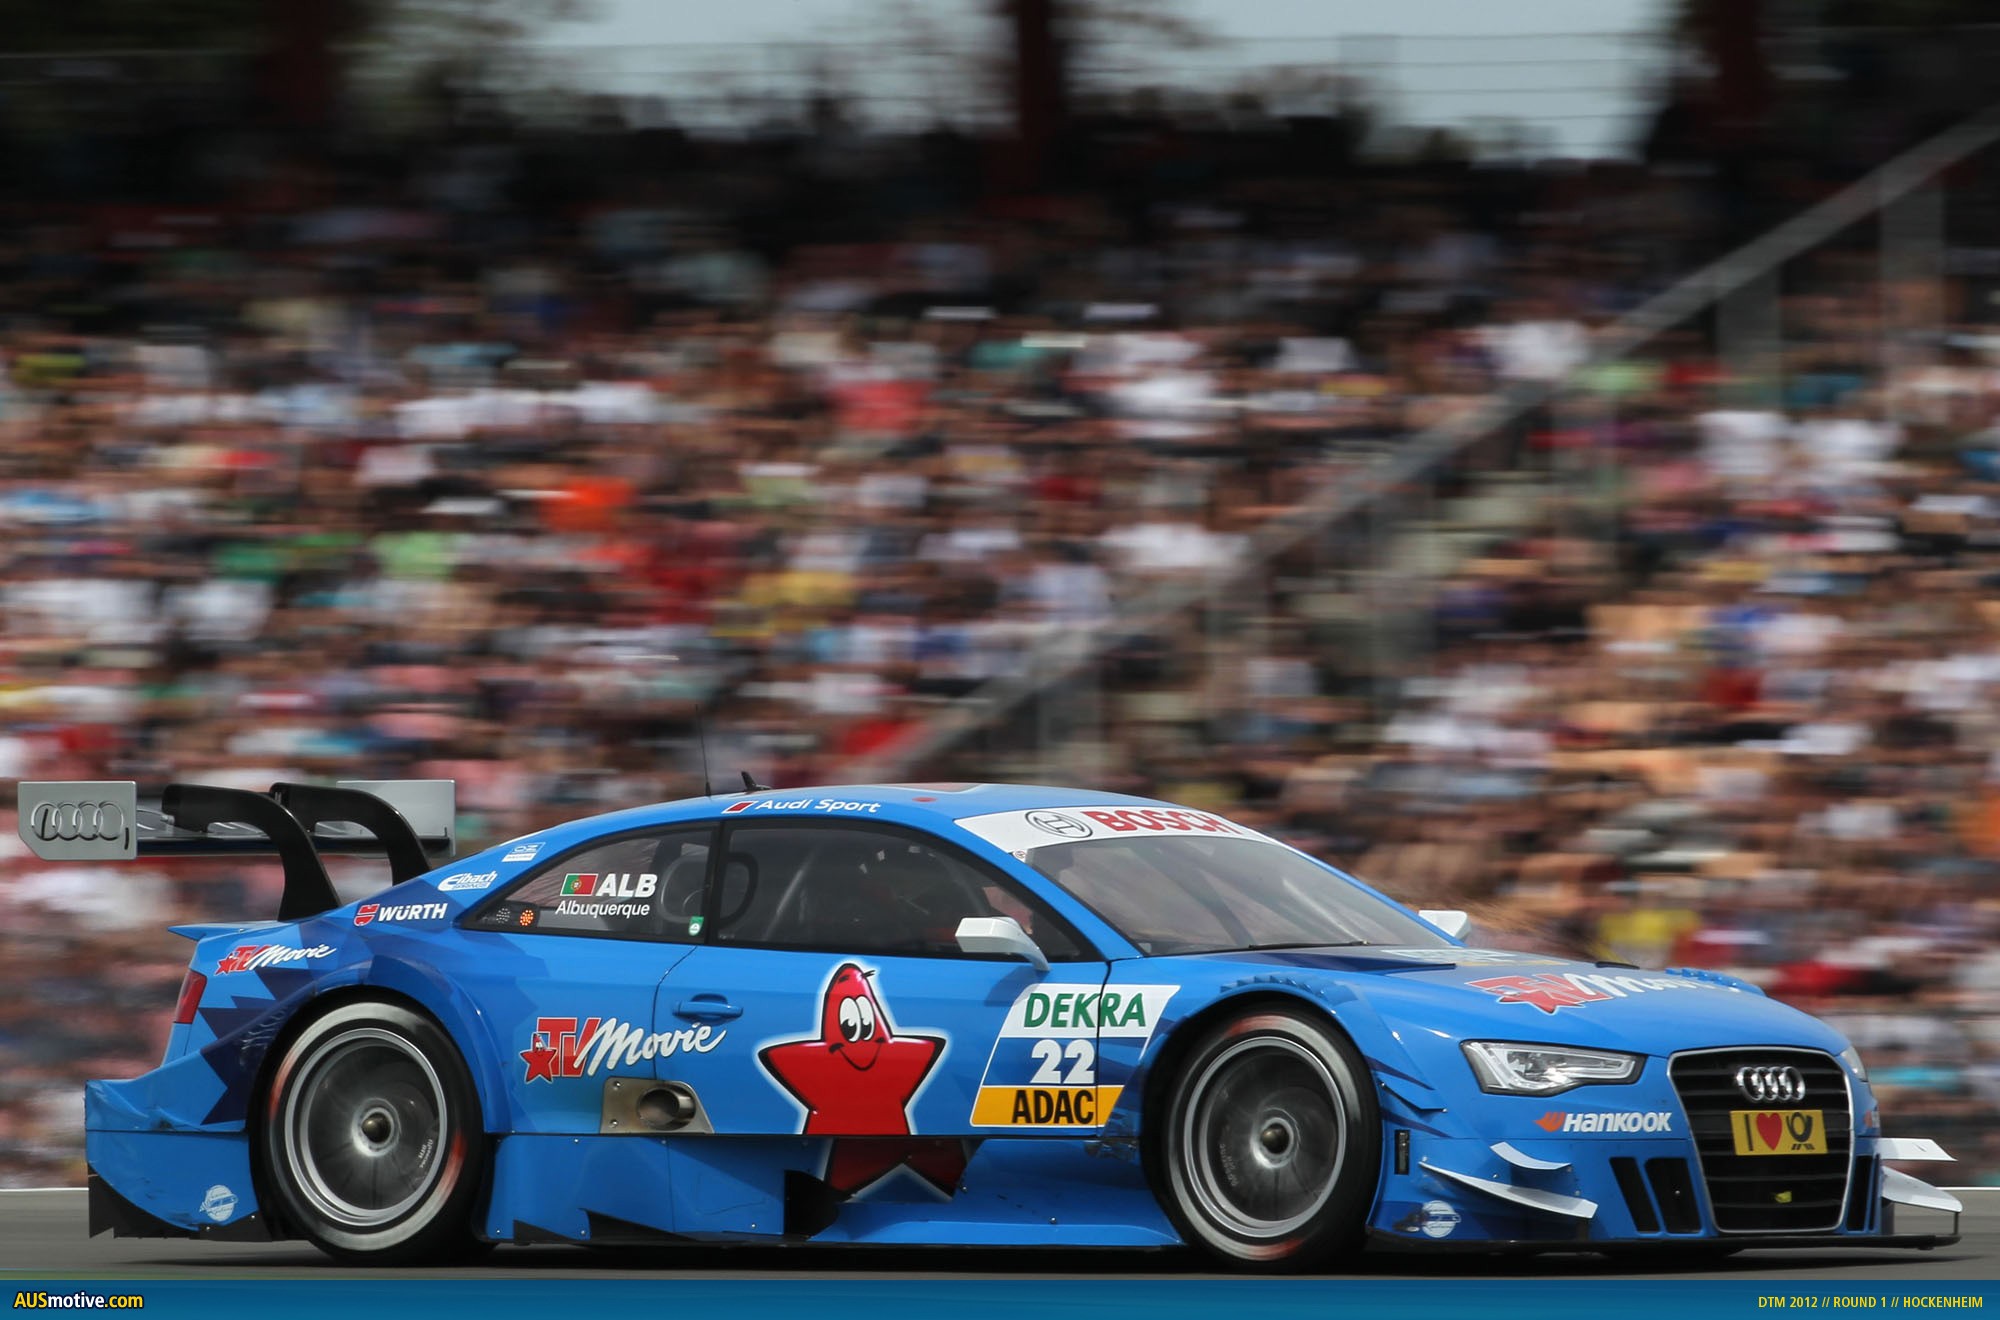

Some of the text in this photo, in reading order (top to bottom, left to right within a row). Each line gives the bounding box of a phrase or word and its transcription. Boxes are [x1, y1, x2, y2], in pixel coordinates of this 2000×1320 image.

[755, 800, 881, 813] Audi Sport
[1081, 809, 1243, 836] BOSCH
[438, 870, 498, 891] Eibach
[595, 873, 658, 898] ALB
[378, 903, 448, 922] WÜRTH
[555, 900, 650, 918] Albuquerque
[243, 944, 337, 970] Movie
[1024, 992, 1146, 1028] DEKRA
[573, 1017, 727, 1076] Movie
[1029, 1039, 1095, 1084] 22
[1012, 1090, 1094, 1124] ADAC
